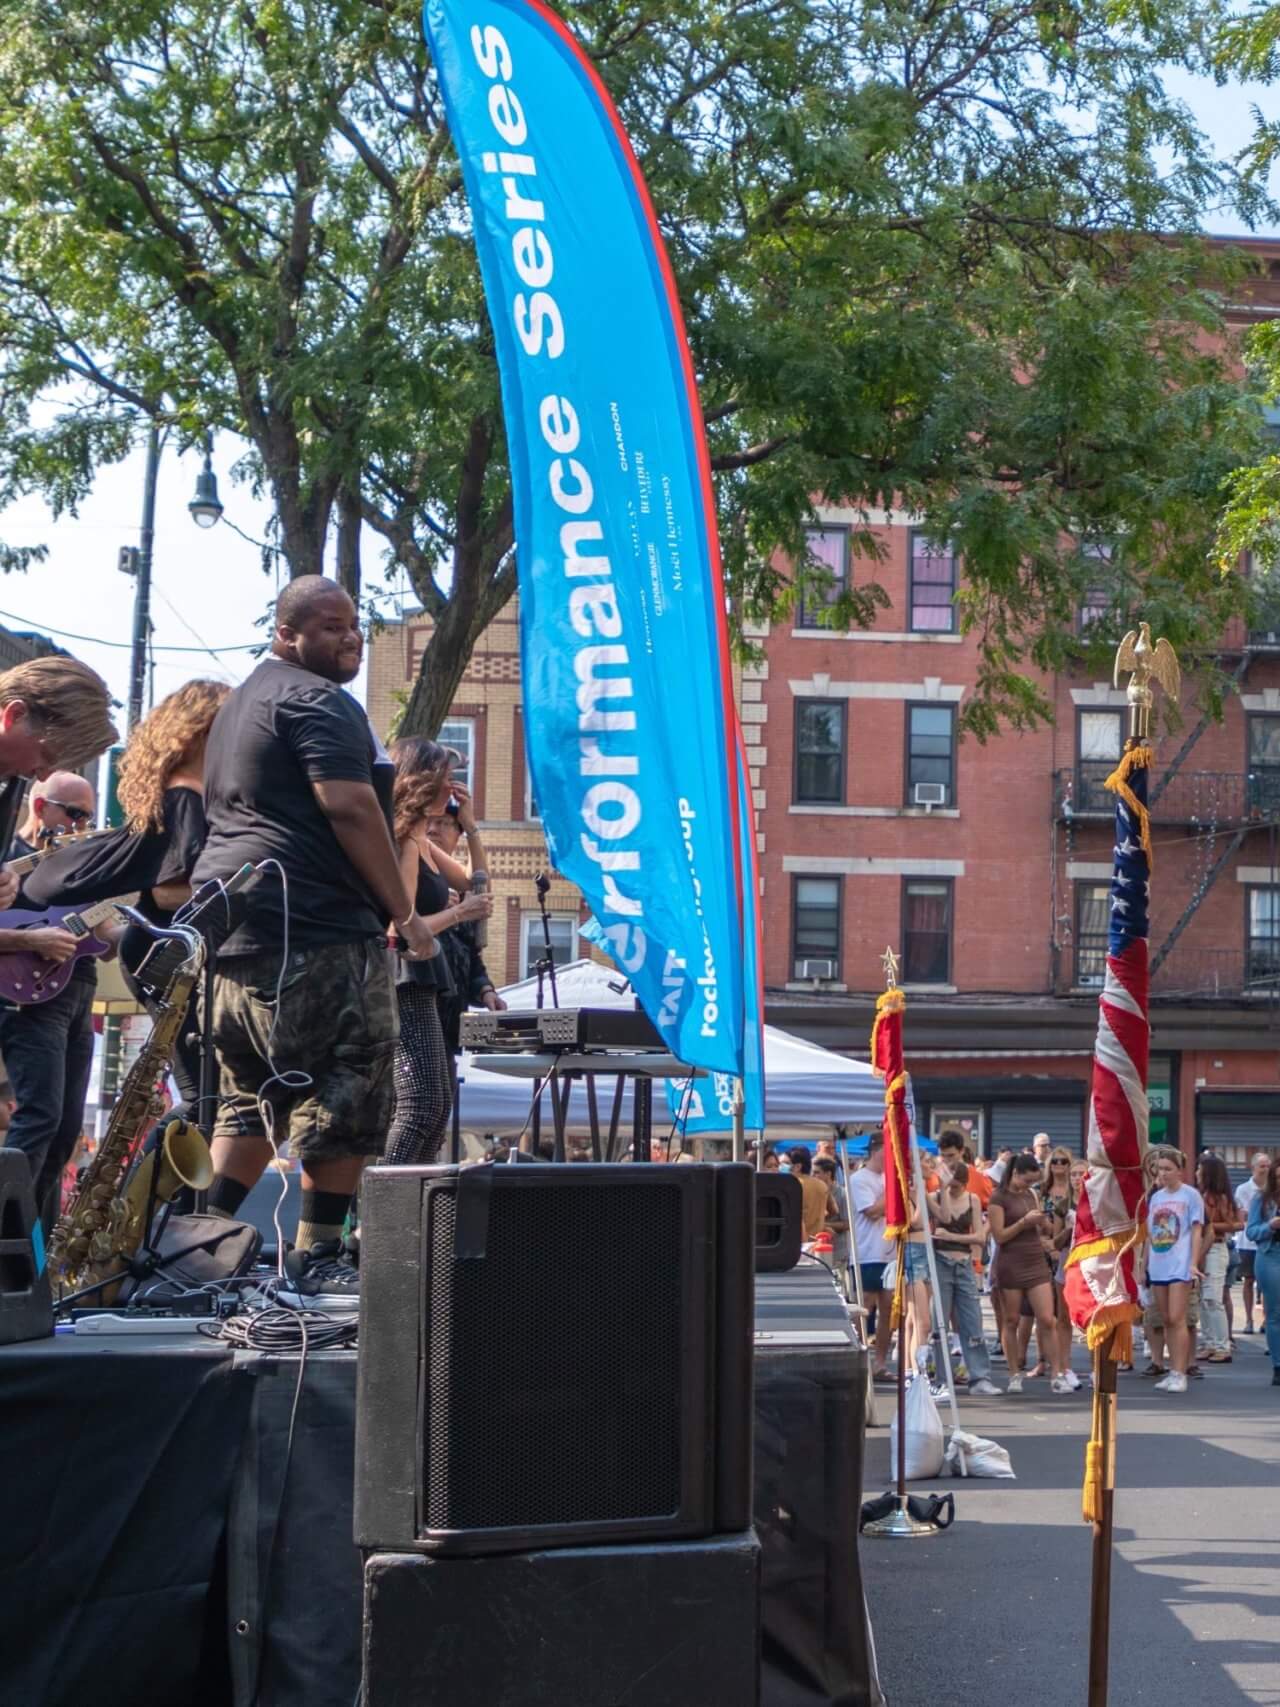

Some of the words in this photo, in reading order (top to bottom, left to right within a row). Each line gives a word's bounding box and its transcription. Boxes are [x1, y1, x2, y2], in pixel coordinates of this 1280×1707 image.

[470, 24, 565, 359] Series
[610, 402, 628, 472] CHANDON
[661, 474, 679, 548] Hennessy
[539, 394, 647, 973] erformance
[658, 949, 688, 1027] TAIT
